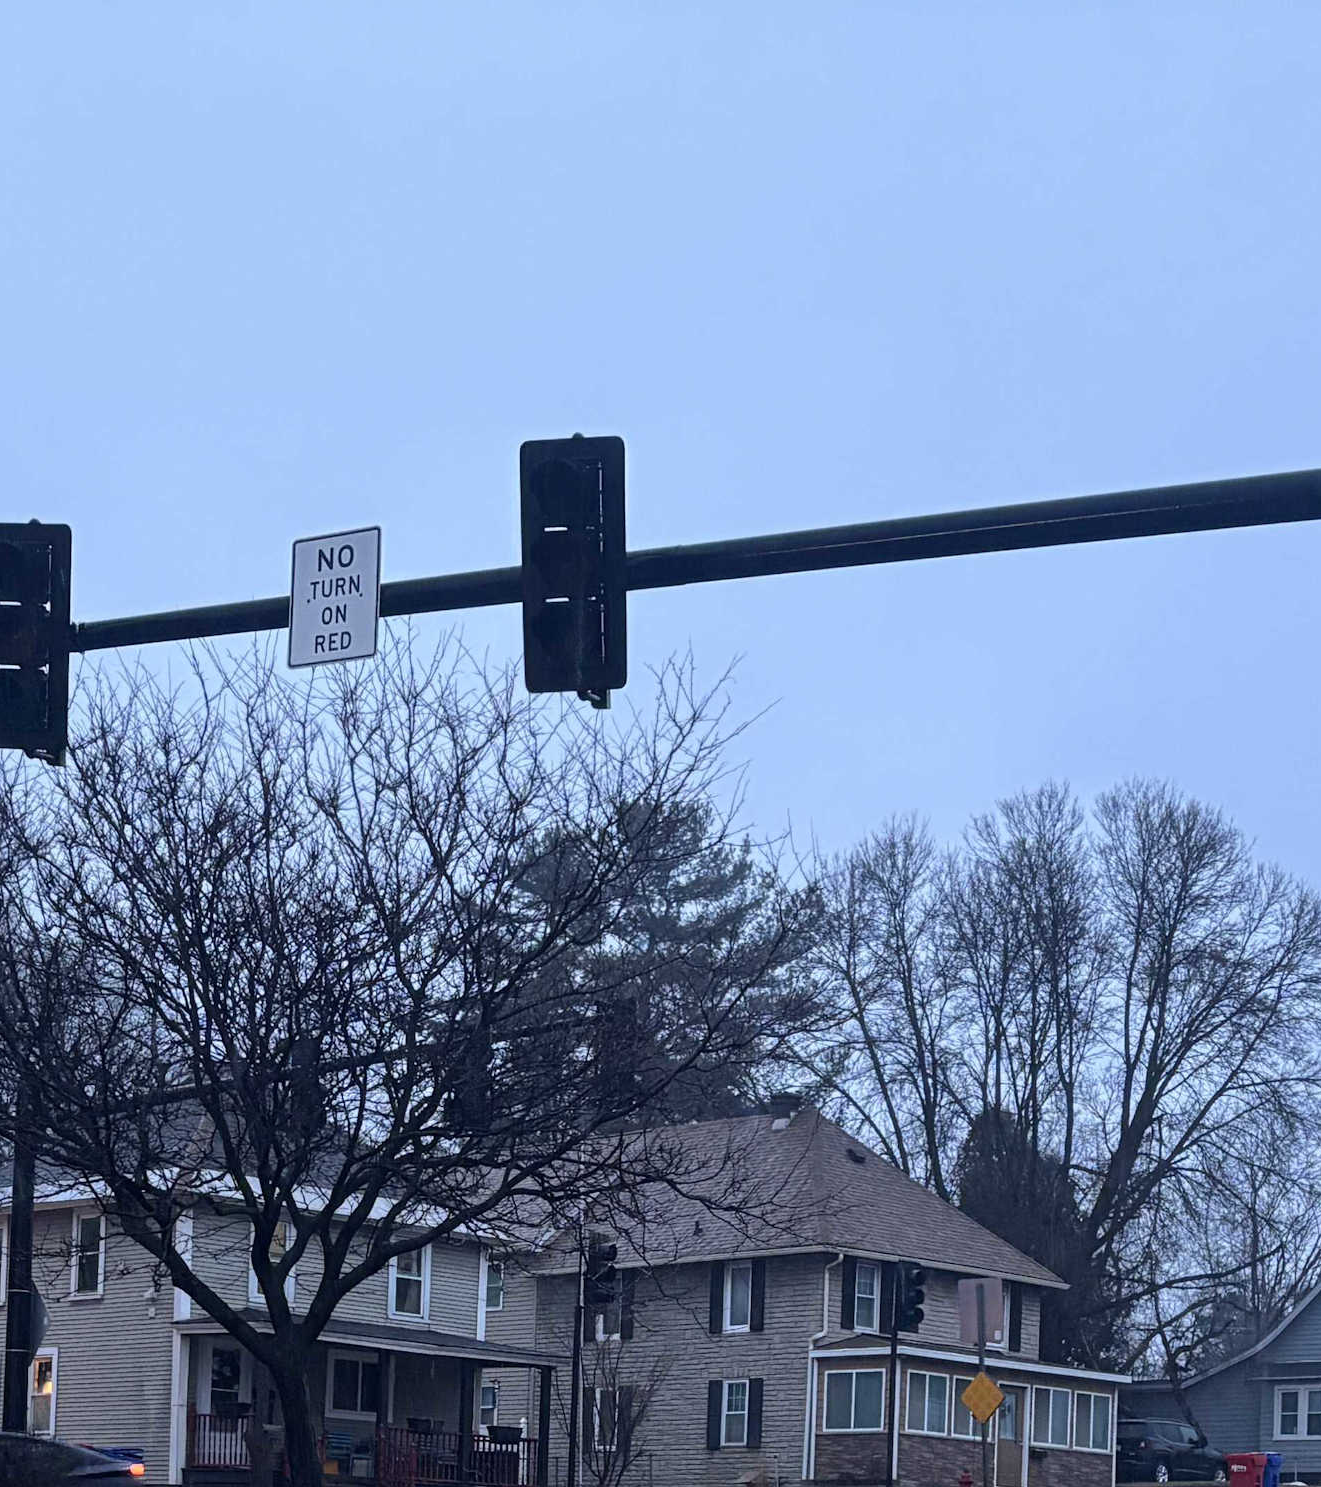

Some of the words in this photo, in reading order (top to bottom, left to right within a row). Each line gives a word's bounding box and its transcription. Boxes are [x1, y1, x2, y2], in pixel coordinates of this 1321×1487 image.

[318, 544, 354, 572] NO
[310, 574, 361, 600] TURN
[321, 604, 347, 625] ON
[314, 631, 352, 654] RED
